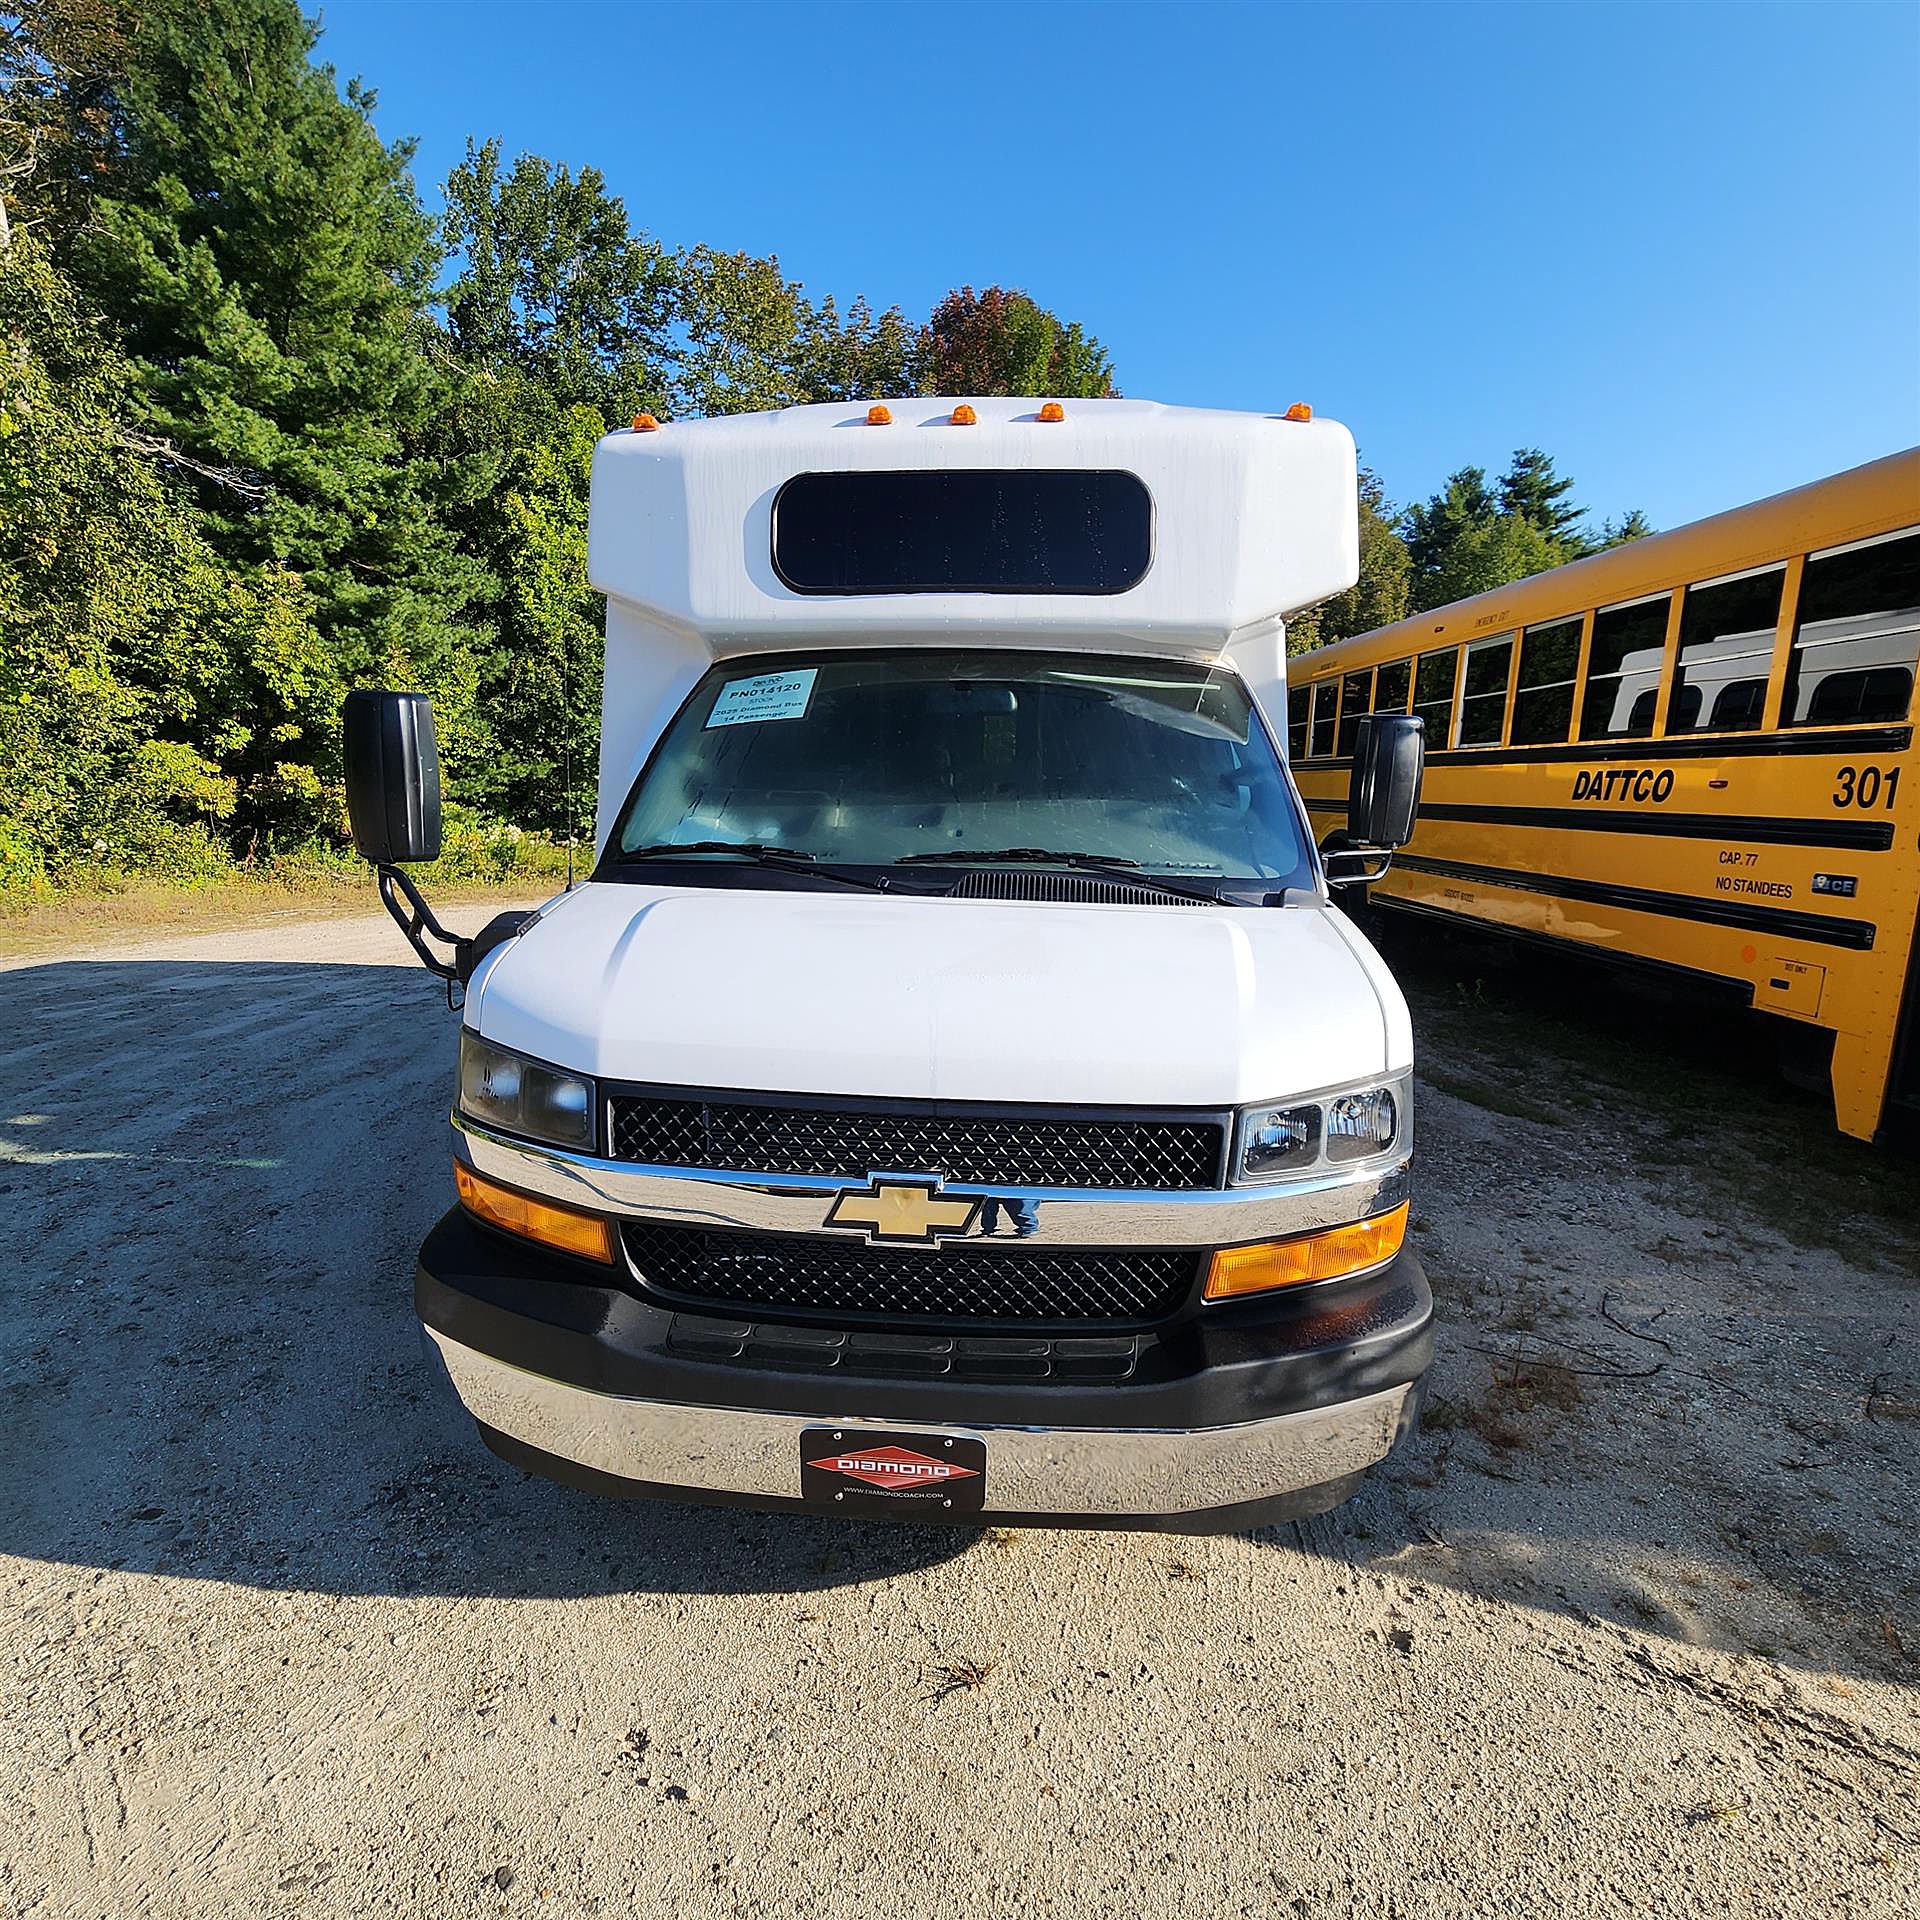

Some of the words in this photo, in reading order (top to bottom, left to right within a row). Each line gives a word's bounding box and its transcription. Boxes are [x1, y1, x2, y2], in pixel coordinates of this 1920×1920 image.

[729, 682, 801, 699] PN014120
[714, 707, 738, 716] 2025
[740, 703, 782, 712] Diamond
[737, 711, 788, 720] Passenger
[1571, 769, 1675, 803] DATTCO
[1832, 765, 1901, 810] 301
[1719, 851, 1743, 866] CAP.
[1744, 853, 1759, 867] 77
[1715, 876, 1732, 890] NO
[1732, 878, 1793, 899] STANDEES
[837, 1459, 950, 1477] DIAMOND
[843, 1486, 944, 1499] WWW.DIAMONDCOACH.COM
